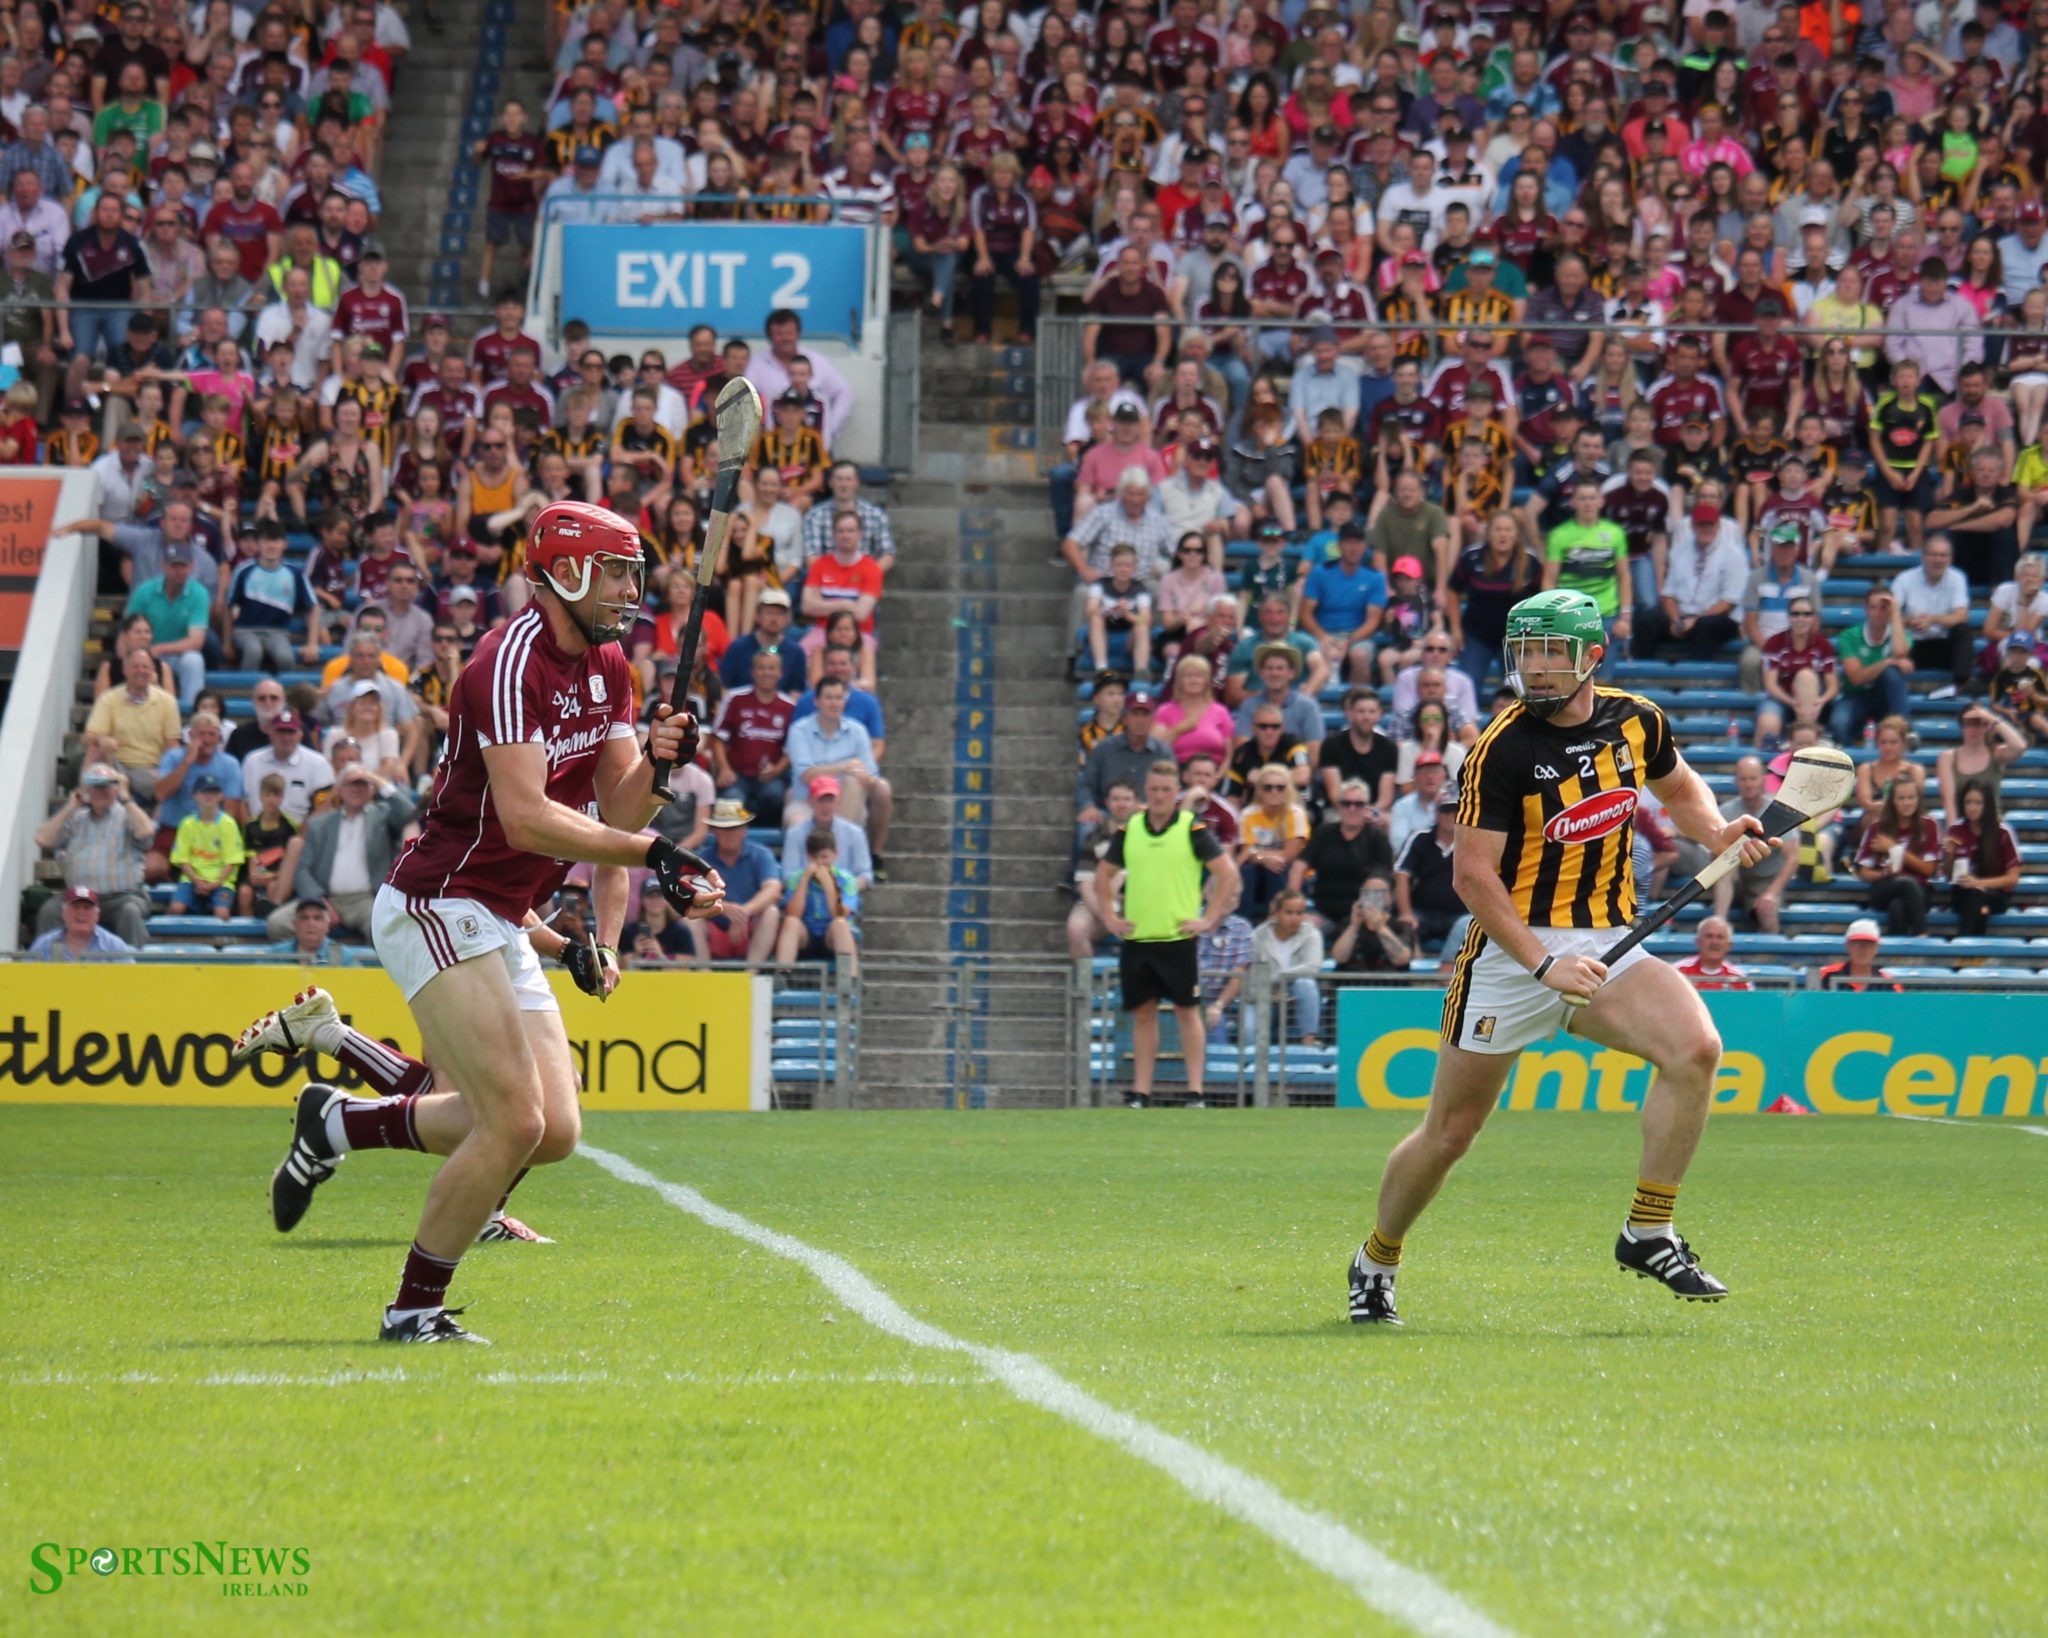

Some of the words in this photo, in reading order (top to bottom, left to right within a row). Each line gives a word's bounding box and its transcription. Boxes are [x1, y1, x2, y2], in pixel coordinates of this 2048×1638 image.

[616, 252, 747, 309] EXIT
[770, 252, 812, 310] 2
[560, 696, 582, 719] 24
[1578, 755, 1595, 778] 2
[964, 830, 977, 851] L
[1356, 1028, 1766, 1113] Cnta
[1804, 1030, 2048, 1117] Cen
